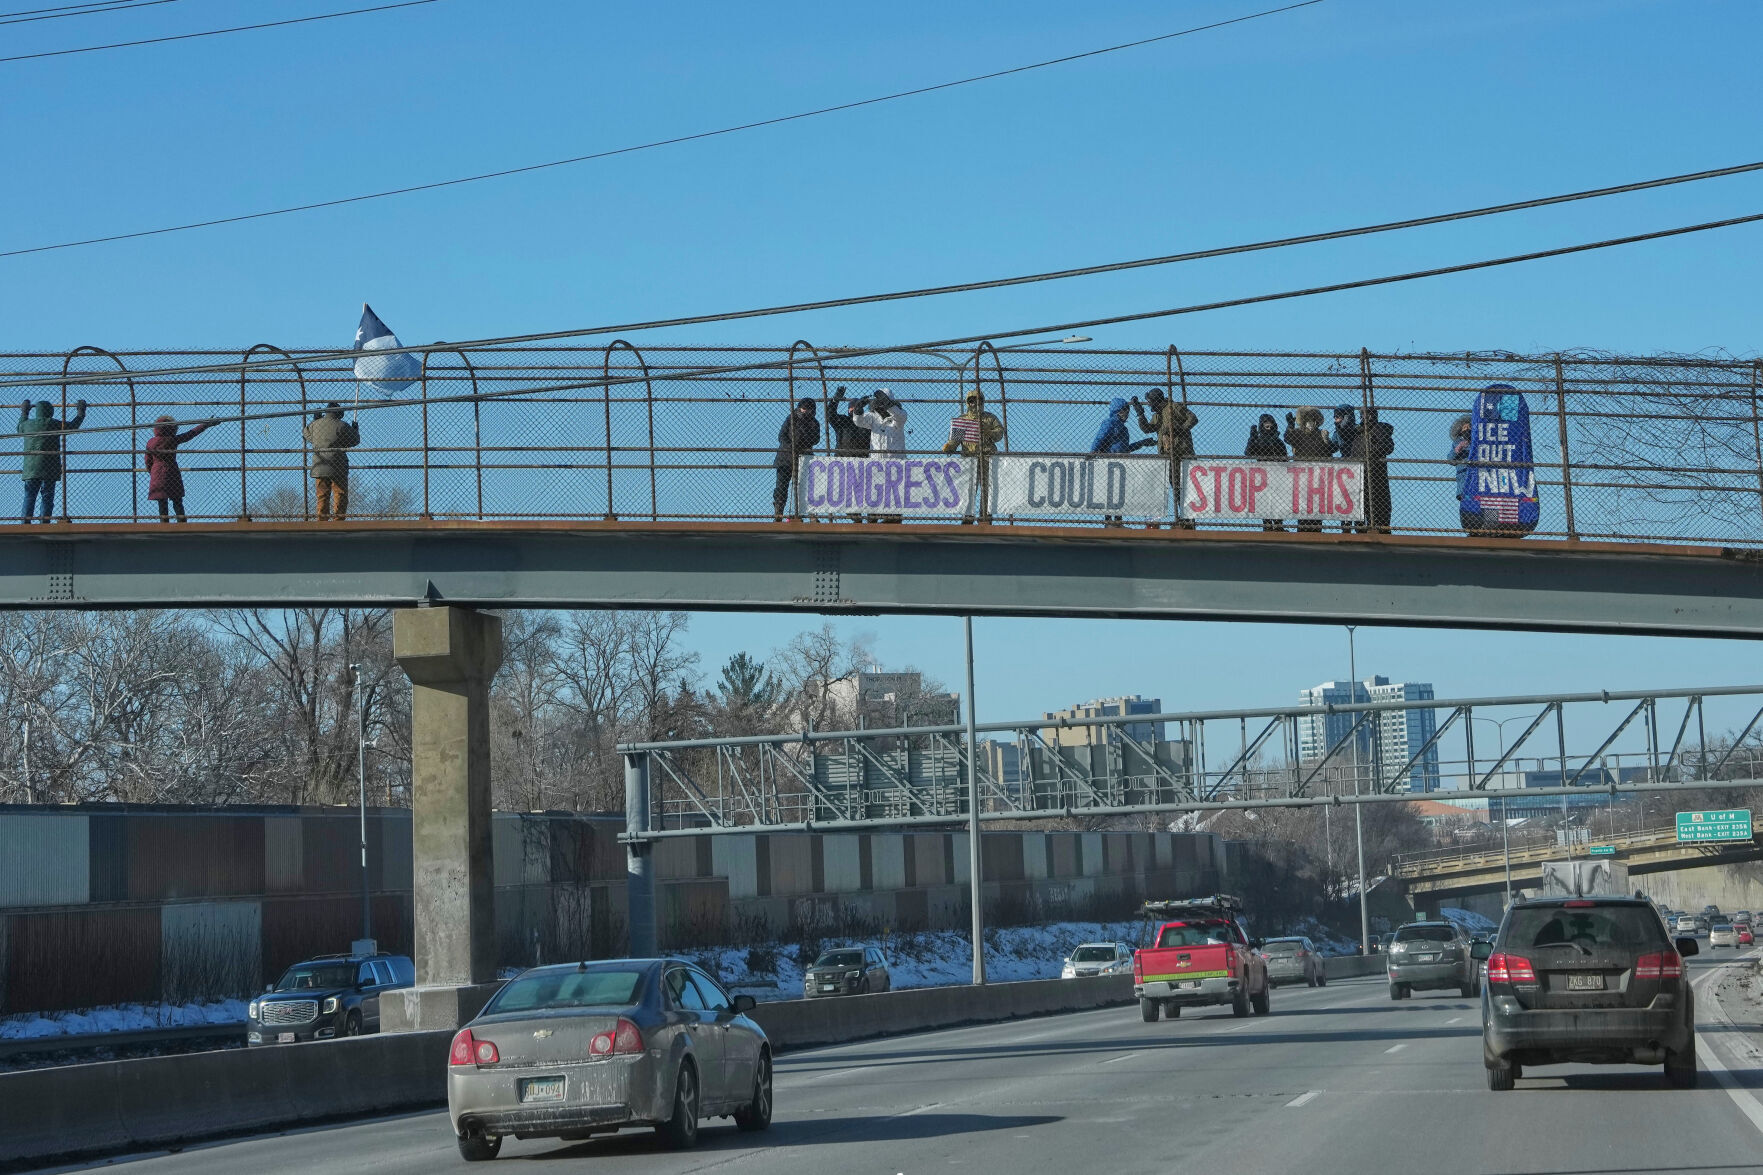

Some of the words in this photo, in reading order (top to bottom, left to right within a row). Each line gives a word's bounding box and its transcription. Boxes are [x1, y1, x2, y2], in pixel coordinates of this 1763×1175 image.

[1478, 422, 1509, 442] ICE
[1478, 444, 1516, 464] OUT
[806, 460, 962, 509] CONGRESS
[1027, 461, 1127, 510] COULD
[1189, 465, 1268, 514] STOP
[1287, 466, 1355, 515] THIS
[1478, 468, 1536, 498] NOW
[1569, 976, 1583, 986] ZKG
[1587, 975, 1601, 986] 870
